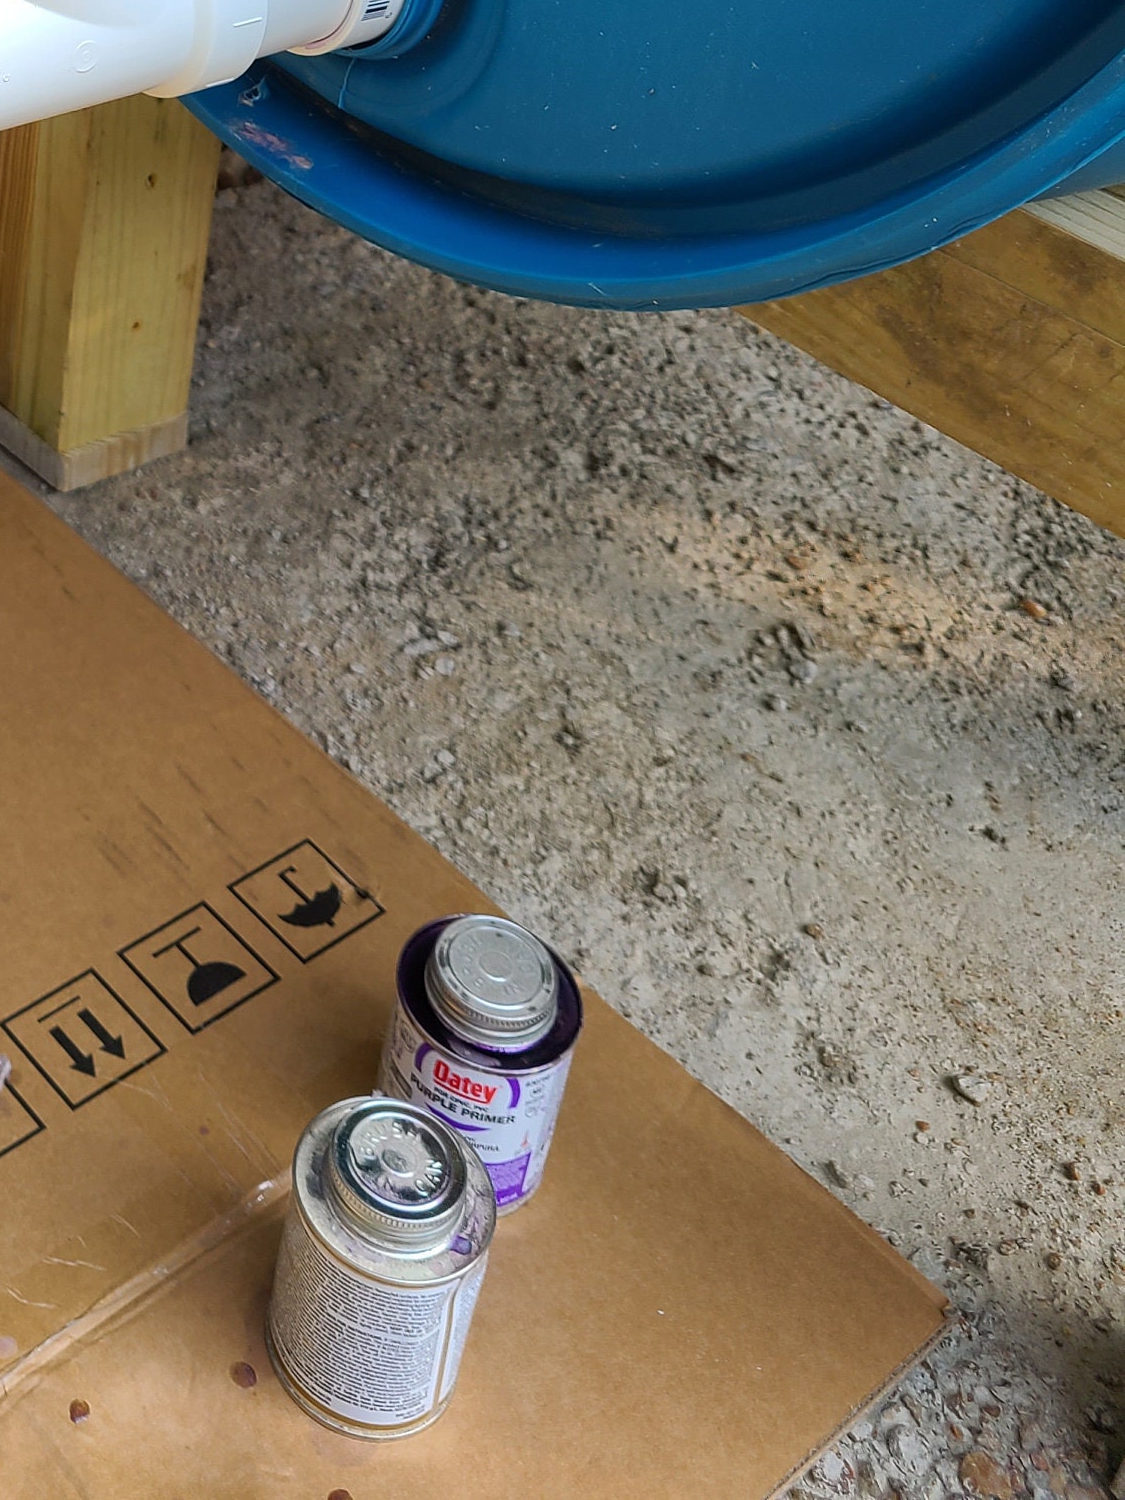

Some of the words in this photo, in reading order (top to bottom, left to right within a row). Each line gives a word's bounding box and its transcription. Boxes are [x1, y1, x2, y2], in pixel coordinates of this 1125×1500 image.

[410, 1072, 458, 1114] PURPLE
[461, 1107, 517, 1125] PRIMER
[433, 1059, 499, 1102] Oatey
